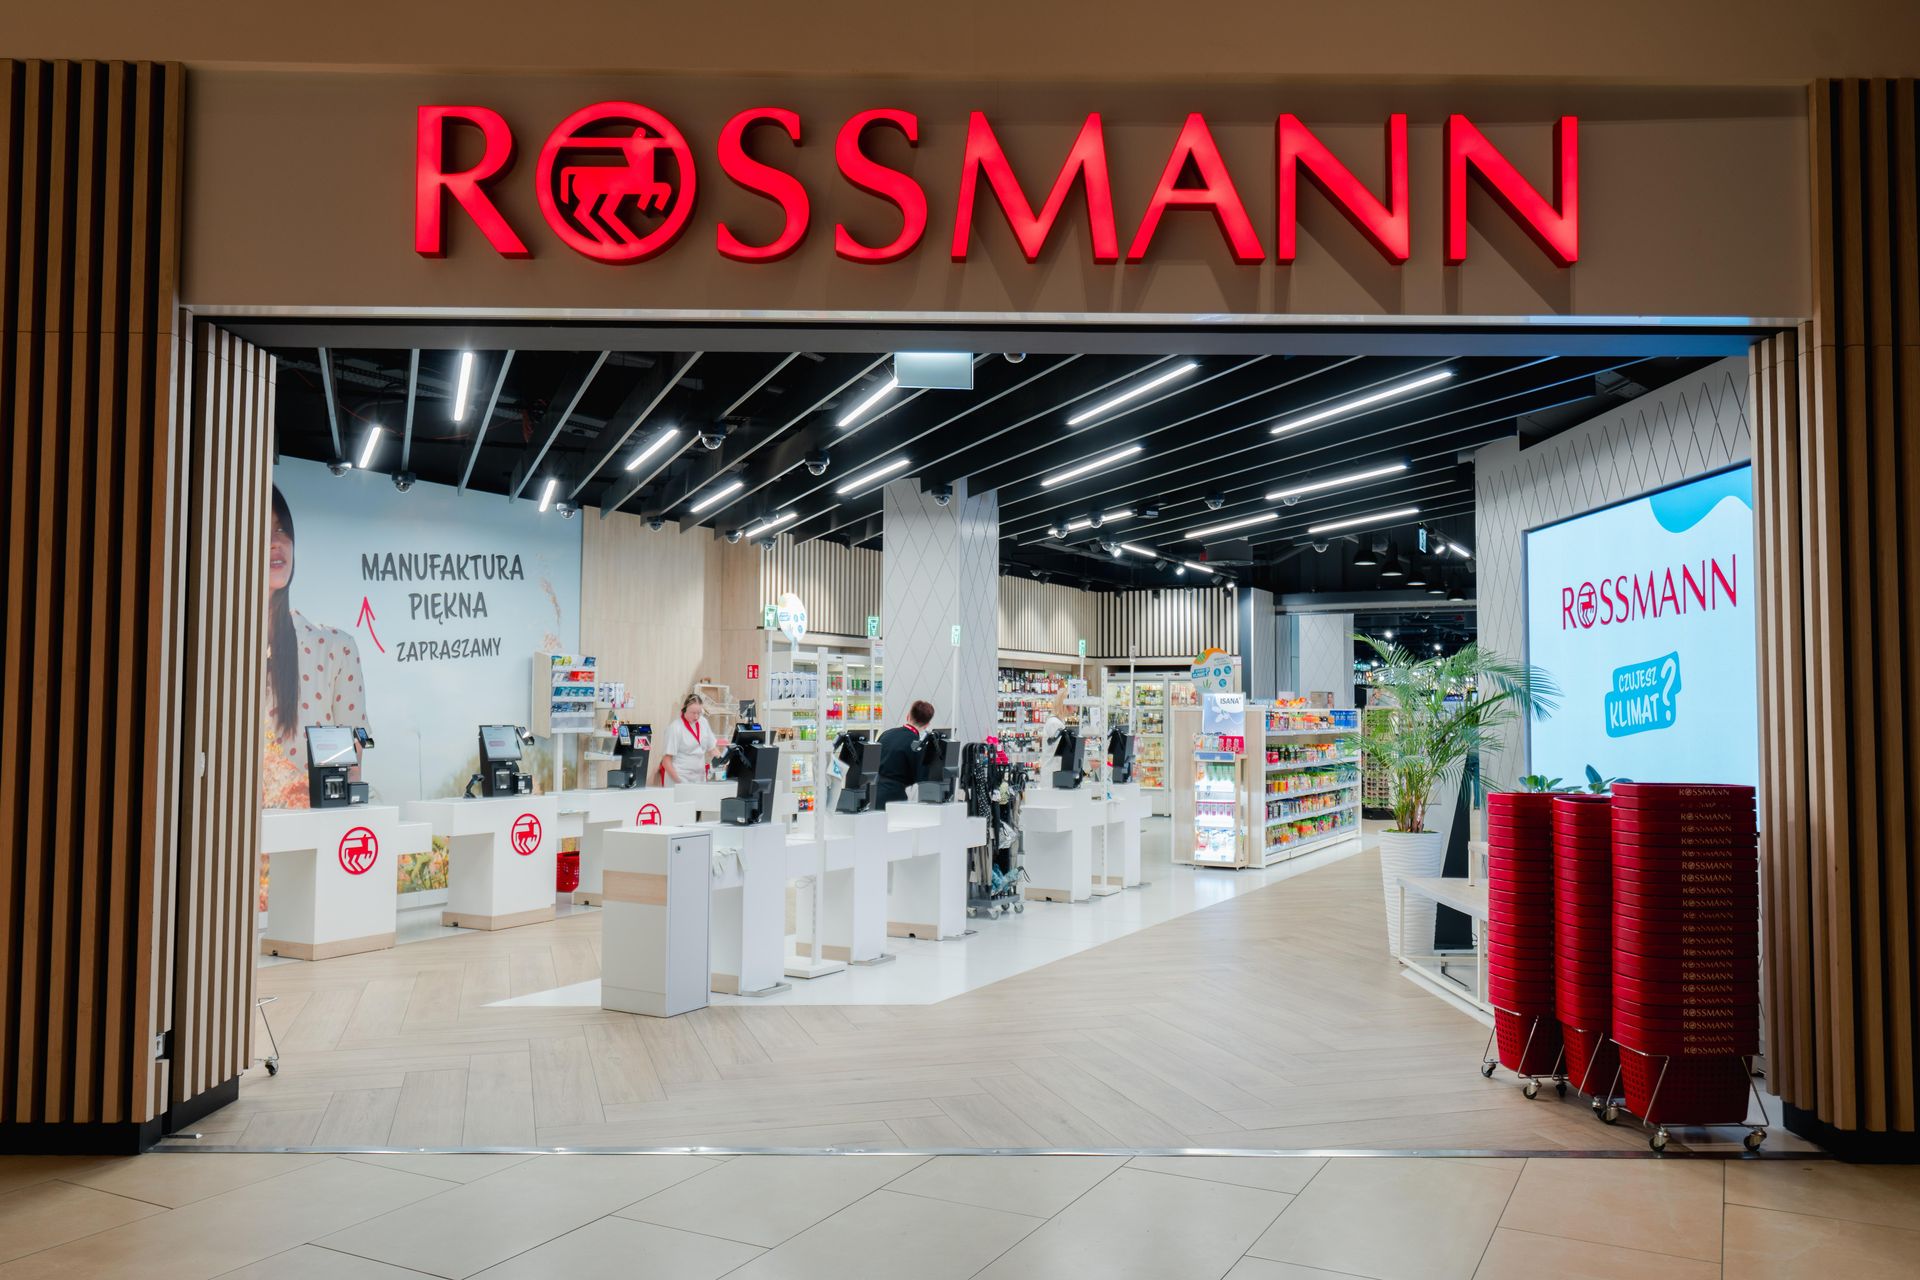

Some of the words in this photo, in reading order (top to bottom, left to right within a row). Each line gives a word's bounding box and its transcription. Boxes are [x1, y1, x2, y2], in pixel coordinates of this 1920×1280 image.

[413, 100, 1582, 266] ROSSMANN
[361, 552, 524, 581] MANUFAKTURA
[1562, 554, 1738, 629] ROSSMANN
[408, 591, 488, 624] PIĘKNA
[397, 637, 501, 662] ZAPRASZAMY
[1618, 666, 1657, 693] CZUJESZ
[1679, 788, 1730, 796] ROSSMANN
[1680, 812, 1732, 821] ROSSMANN
[1682, 861, 1733, 870] ROSSMANN
[1681, 874, 1732, 882] ROSSMANN
[1682, 972, 1734, 980] ROSSMANN
[1682, 984, 1733, 992] ROSSMANN
[1683, 1008, 1734, 1017] ROSSMANN
[1683, 1021, 1734, 1029] ROSSMANN
[1684, 1046, 1735, 1054] ROSSMANN
